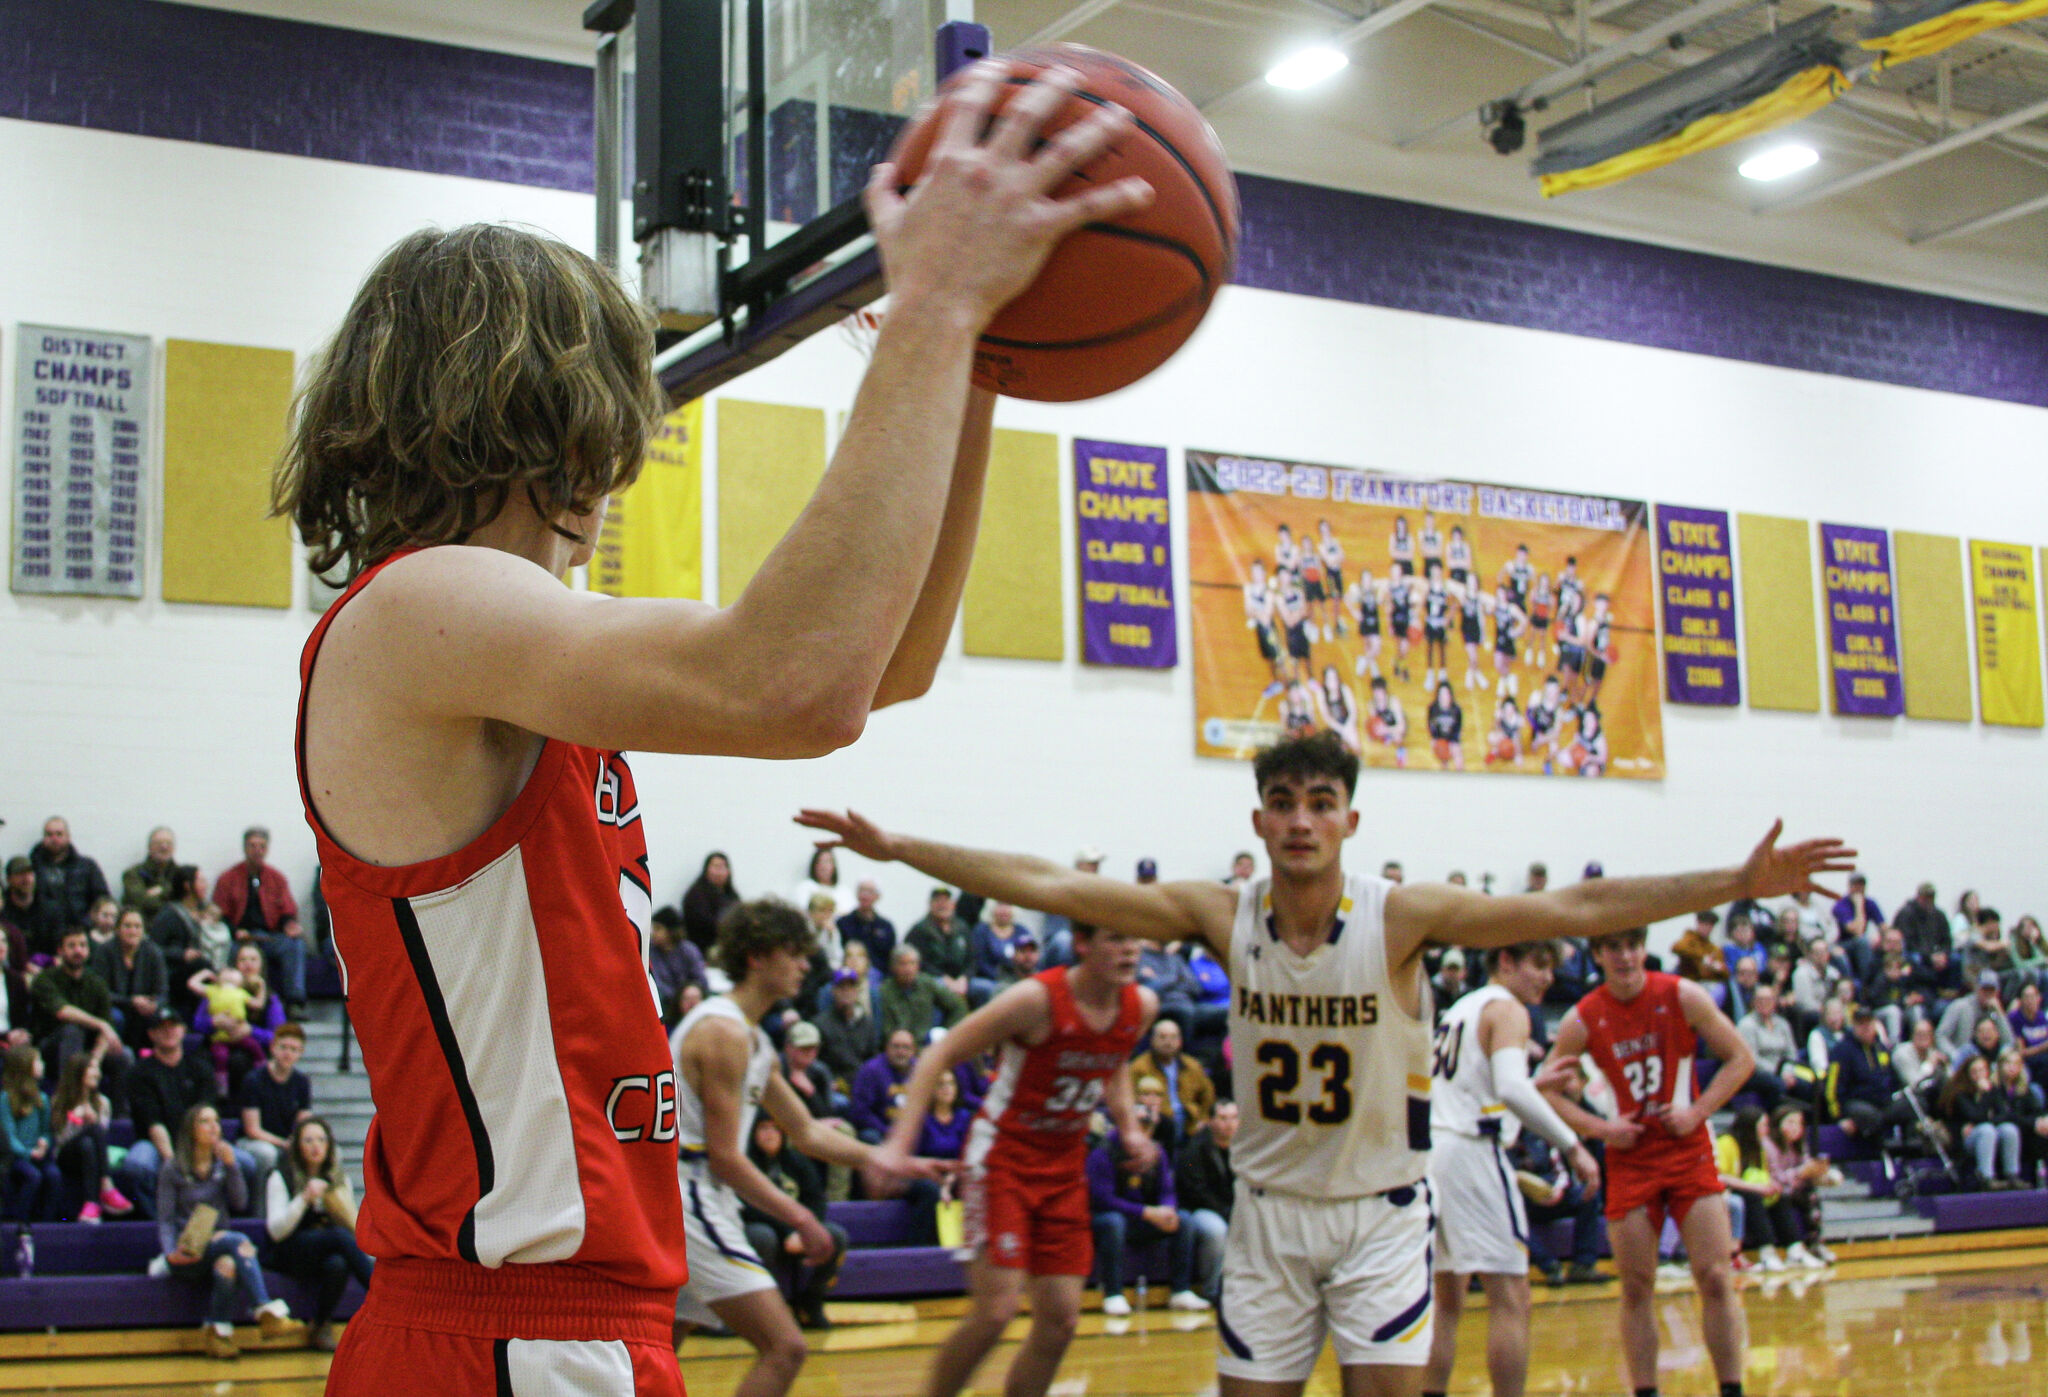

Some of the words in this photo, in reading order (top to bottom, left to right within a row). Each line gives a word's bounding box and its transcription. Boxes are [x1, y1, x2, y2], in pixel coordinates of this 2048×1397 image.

[42, 336, 125, 360] DISTRICT
[34, 358, 131, 390] CHAMPS
[36, 386, 128, 414] SOFTBALL
[1090, 458, 1156, 490] STATE
[1079, 491, 1168, 524] CHAMPS
[1215, 456, 1328, 501] 2022-23
[1331, 470, 1473, 516] FRANKFORT
[1478, 485, 1627, 531] BASKETBALL
[1669, 520, 1720, 549] STATE
[1087, 540, 1145, 564] CLASS
[1662, 551, 1731, 580] CHAMPS
[1834, 538, 1880, 566] STATE
[1827, 567, 1890, 596] CHAMPS
[1983, 564, 2027, 582] CHAMPS
[1086, 581, 1170, 608] SOFTBALL
[1668, 586, 1712, 608] CLASS
[1834, 603, 1876, 623] CLASS
[1664, 635, 1736, 658] BASKETBALL
[1834, 652, 1897, 674] BASKETBALL
[1238, 985, 1379, 1028] PANTHERS
[1256, 1037, 1353, 1126] 23
[1623, 1053, 1663, 1103] 23
[603, 1069, 682, 1144] CE
